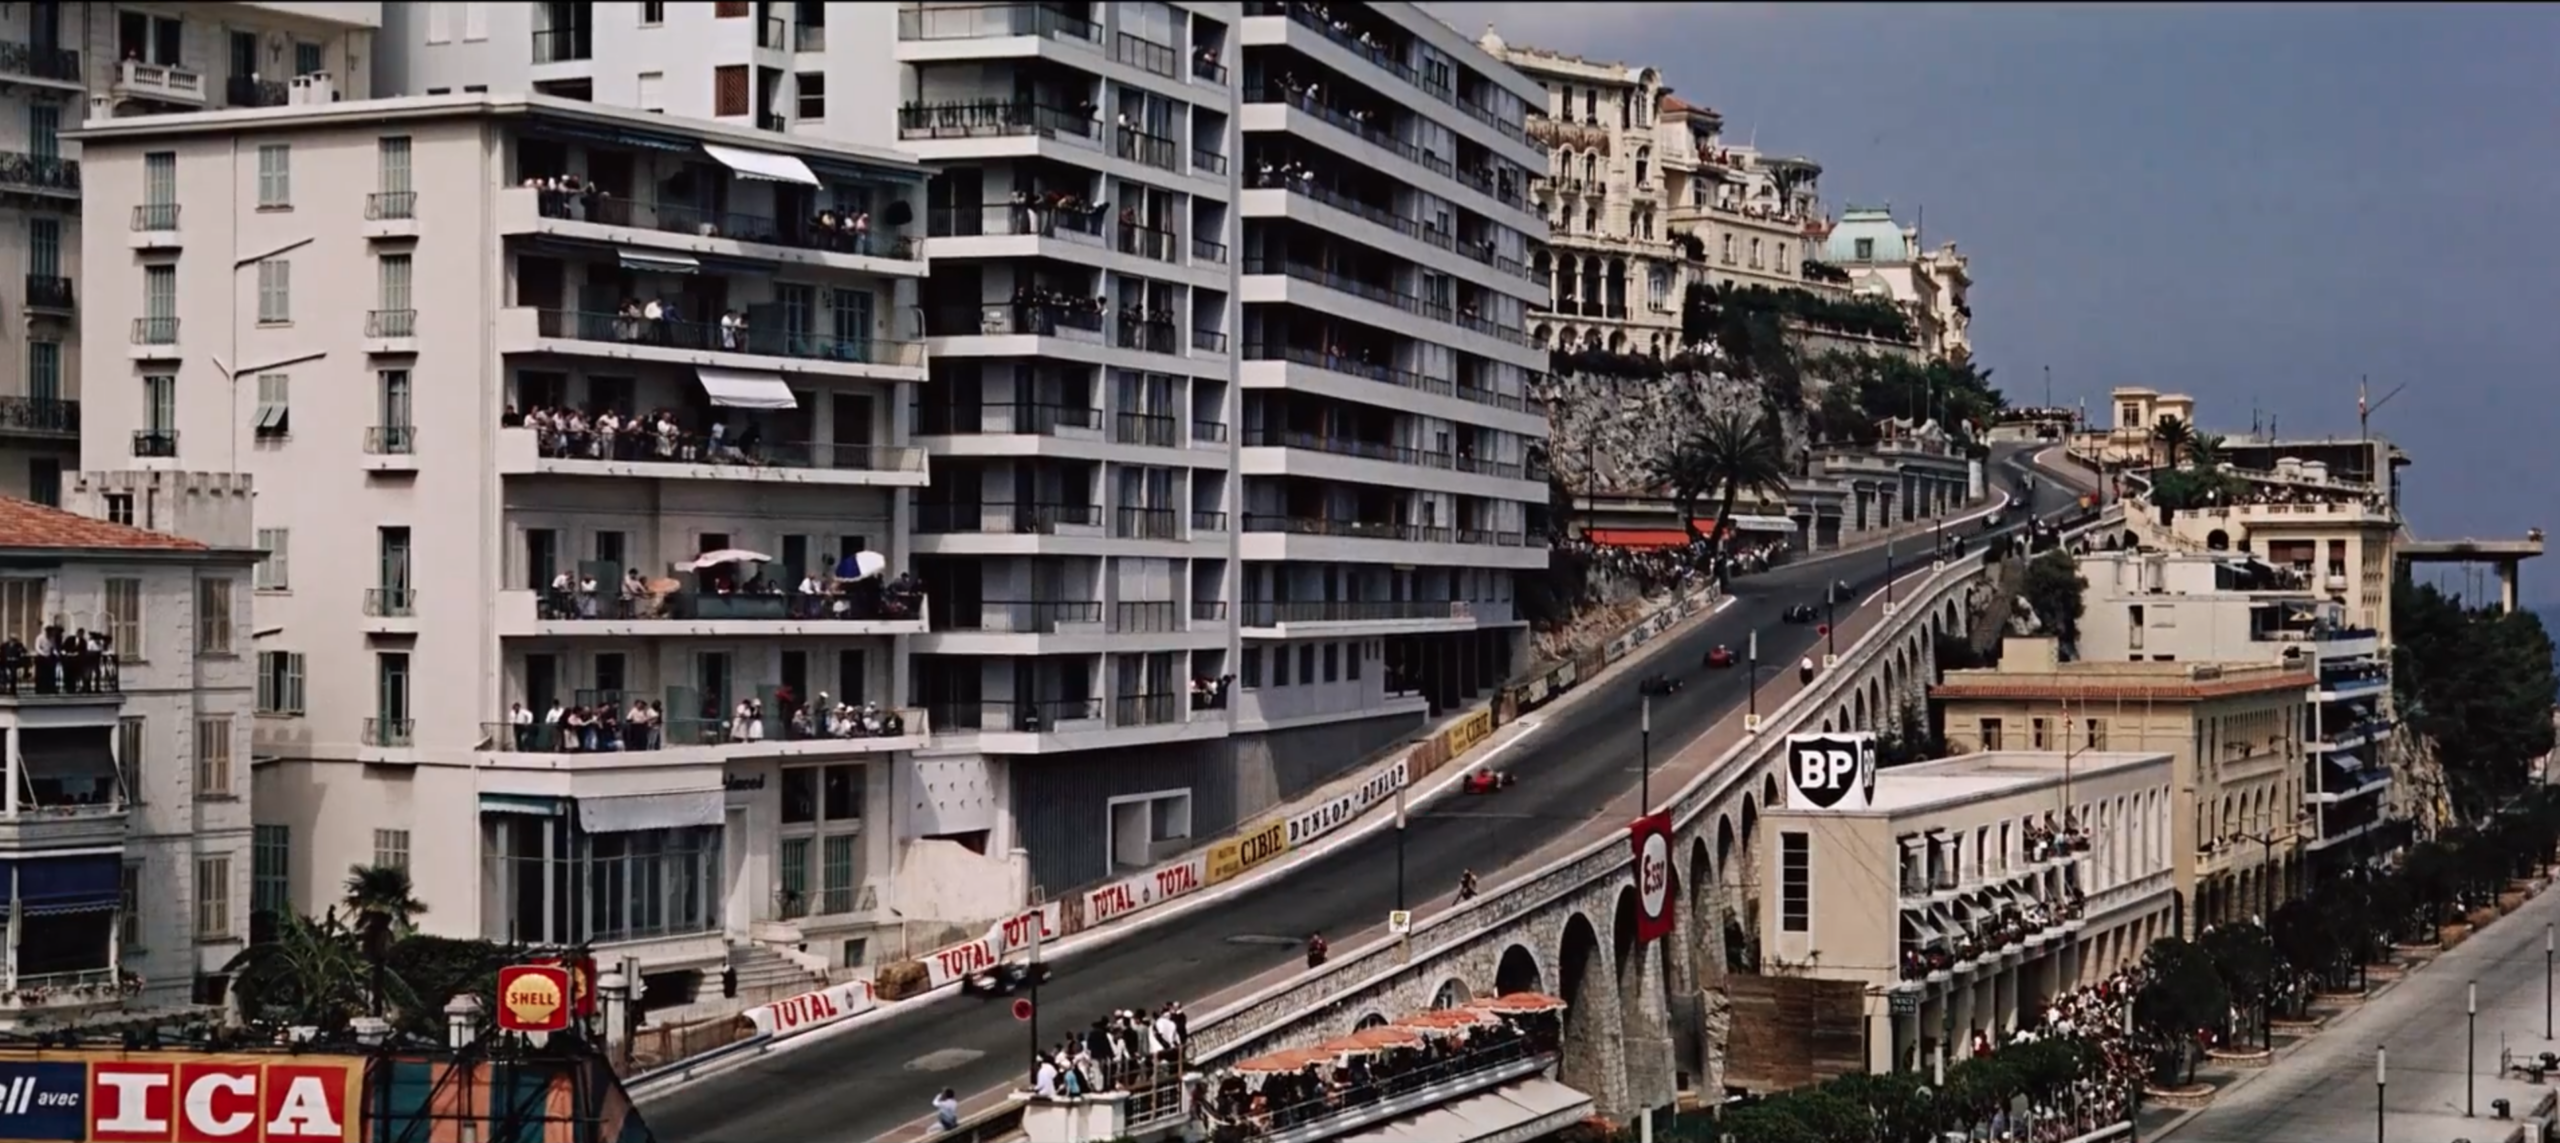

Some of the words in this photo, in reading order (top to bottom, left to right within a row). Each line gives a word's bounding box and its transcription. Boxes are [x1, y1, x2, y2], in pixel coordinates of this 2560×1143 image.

[1799, 750, 1853, 789] BP
[1863, 749, 1875, 788] BP
[1291, 798, 1350, 842] DUNLOP
[1362, 764, 1405, 805] DUNLOP
[1240, 824, 1284, 866] CIBIE
[1092, 883, 1136, 922] TOTAL
[1156, 862, 1198, 899] TOTAL
[1643, 854, 1665, 896] Esso
[1003, 909, 1051, 952] TOTL
[937, 940, 995, 979] TOTAL
[510, 992, 556, 1006] SHELL
[767, 993, 838, 1031] TOTAL
[37, 1092, 79, 1107] avec
[97, 1072, 342, 1137] ICA
